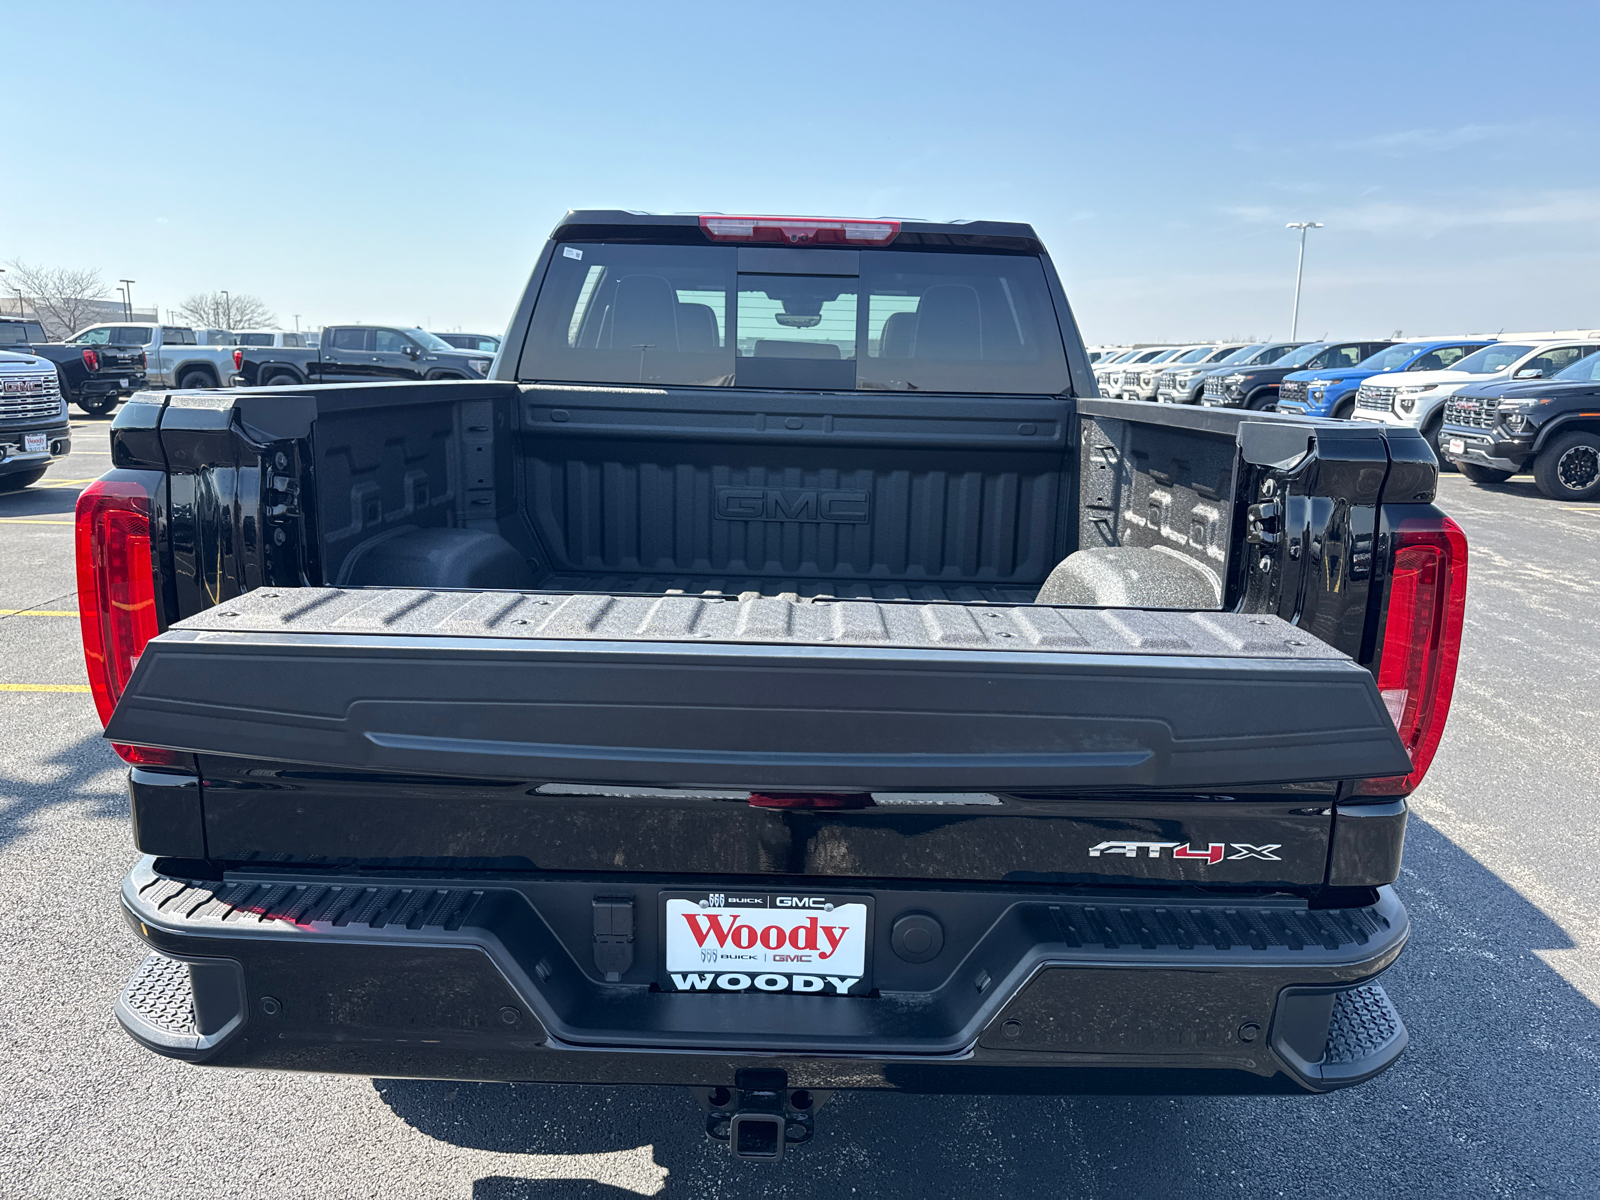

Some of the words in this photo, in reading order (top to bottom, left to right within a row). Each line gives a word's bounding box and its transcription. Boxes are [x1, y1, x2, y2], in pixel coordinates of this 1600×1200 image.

[5, 381, 42, 392] GMC
[717, 489, 867, 521] GMC
[1089, 840, 1282, 865] AT4X
[776, 896, 825, 907] GMC
[681, 913, 850, 960] Woody
[773, 954, 812, 962] GMC
[670, 973, 860, 994] WOODY
